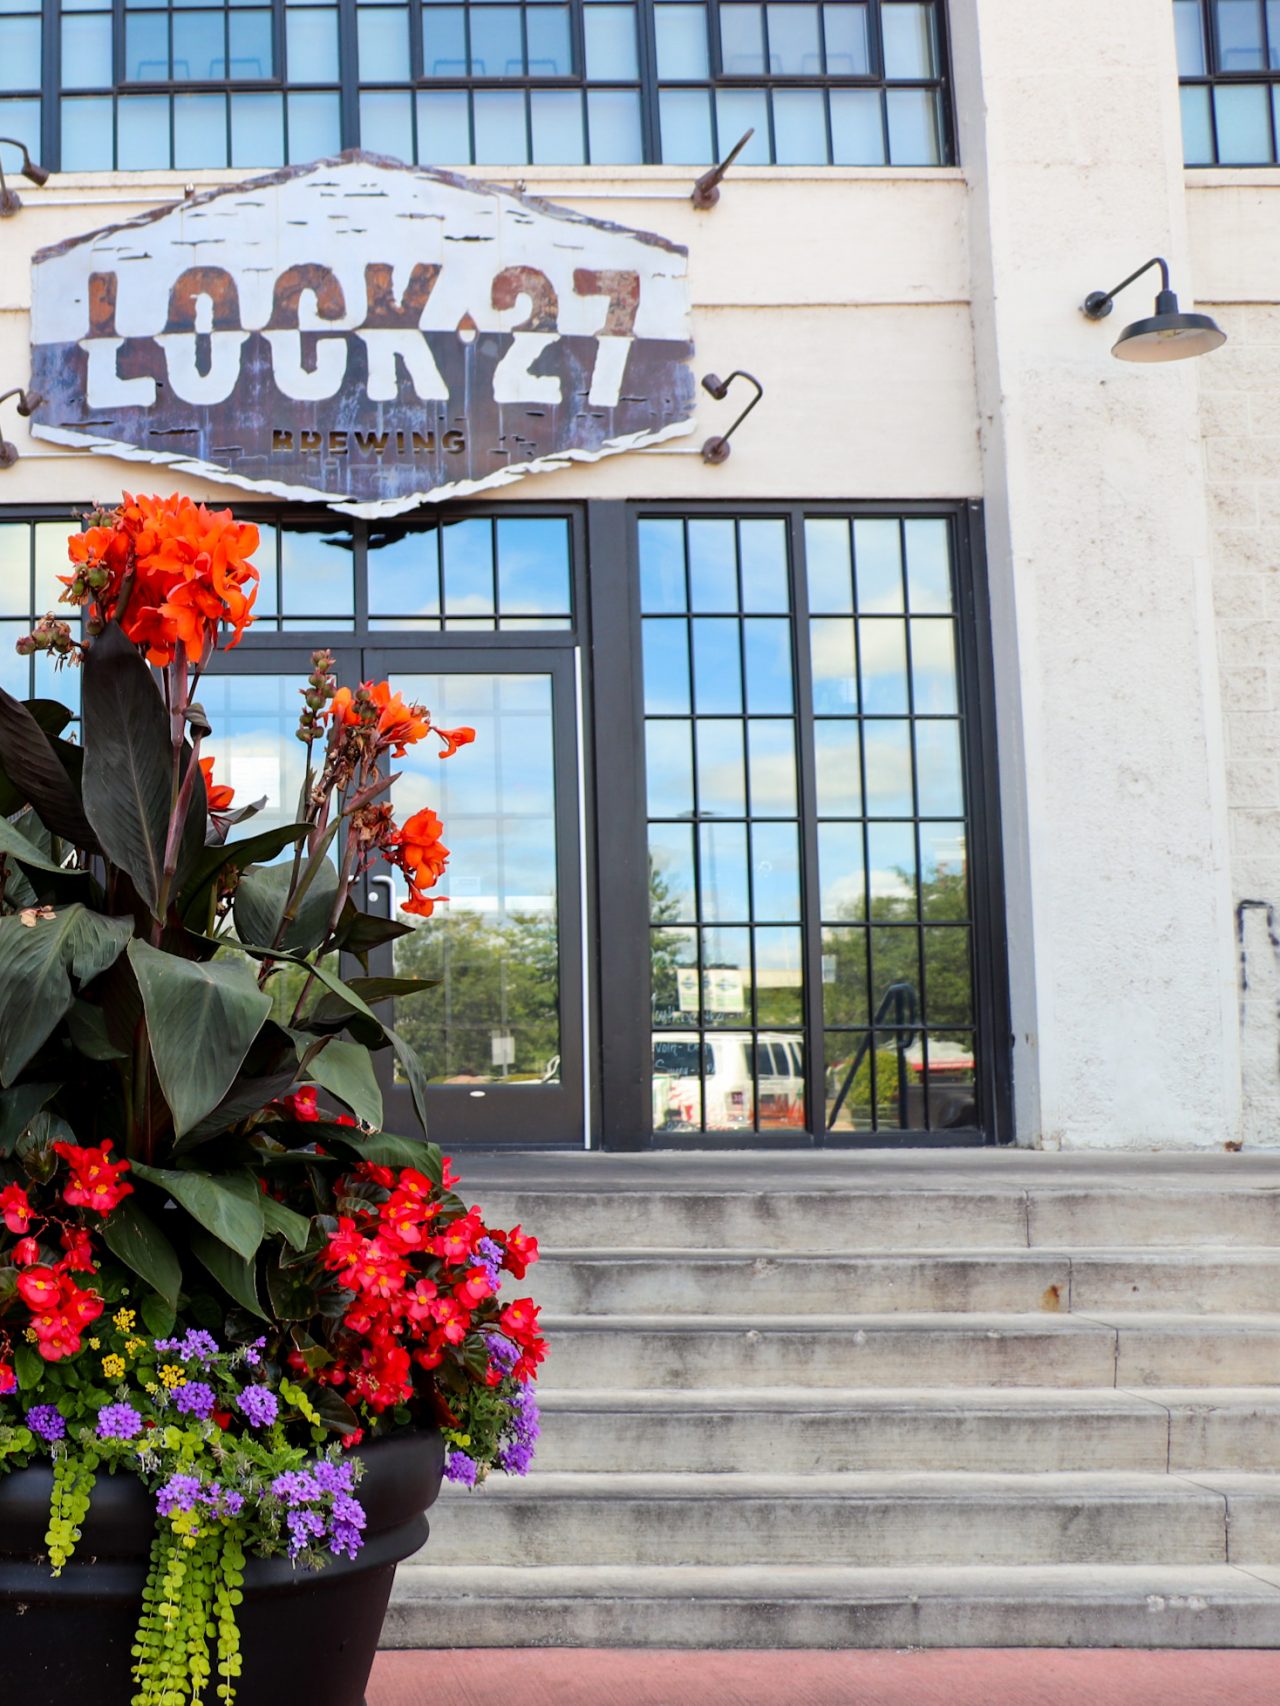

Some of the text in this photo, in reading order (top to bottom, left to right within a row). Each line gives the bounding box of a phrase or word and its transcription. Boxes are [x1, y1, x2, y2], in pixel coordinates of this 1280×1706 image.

[85, 262, 641, 407] LOCK 27
[272, 429, 467, 455] BREWING
